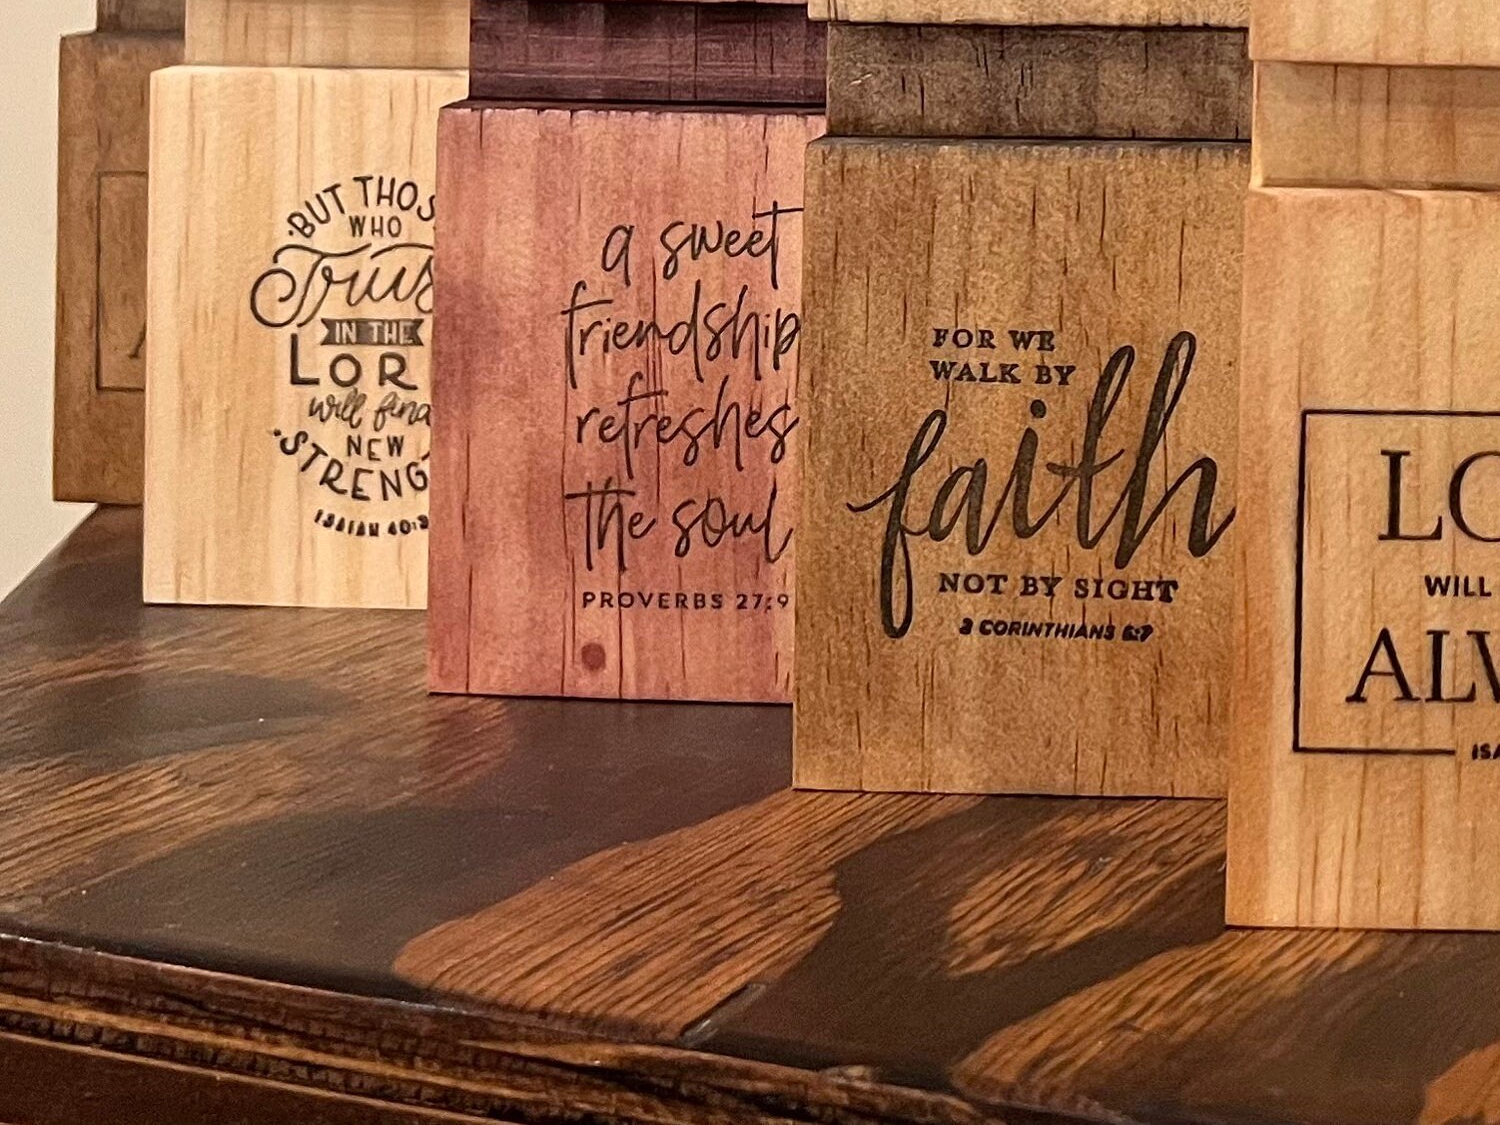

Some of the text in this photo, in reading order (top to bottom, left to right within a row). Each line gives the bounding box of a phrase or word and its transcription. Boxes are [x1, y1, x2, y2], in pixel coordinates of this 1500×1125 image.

[354, 176, 436, 222] THOS
[349, 215, 401, 238] WHO
[601, 200, 804, 290] a sweet
[250, 242, 433, 328] Trus
[334, 321, 413, 345] IN THE
[561, 279, 801, 389] friendship
[932, 328, 1056, 352] FOR WE
[290, 332, 418, 390] LOR
[929, 360, 1077, 386] WALK BY
[308, 388, 366, 429] will
[576, 371, 799, 480] refreshes
[279, 428, 431, 501] STRENG
[347, 435, 404, 461] NEW
[846, 330, 1237, 639] faith
[314, 509, 429, 537] ISAIAH 40:3
[564, 477, 793, 573] the soul
[582, 591, 790, 611] PROVERBS 27:9
[938, 573, 1179, 604] NOT BY SIGHT
[1424, 576, 1492, 598] WILL
[979, 619, 1116, 641] CORINTHIANS
